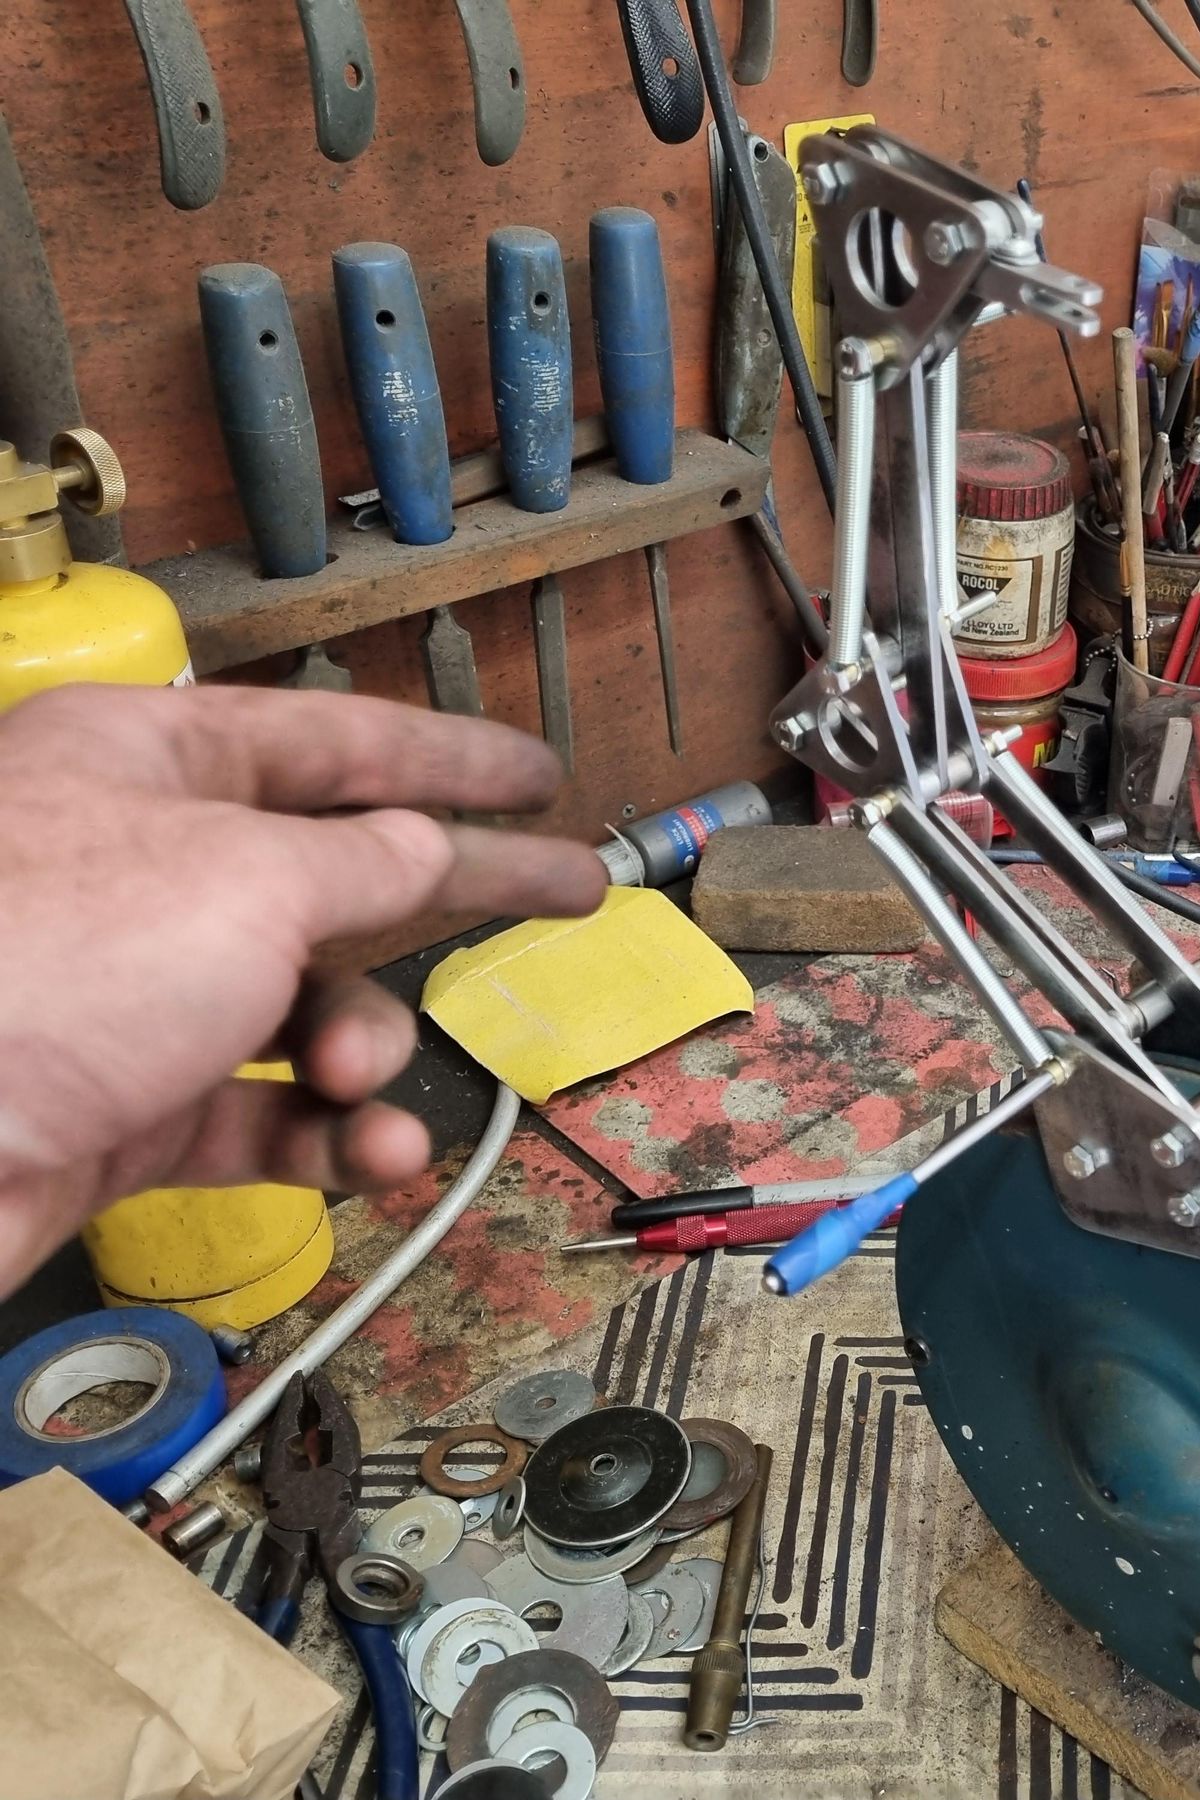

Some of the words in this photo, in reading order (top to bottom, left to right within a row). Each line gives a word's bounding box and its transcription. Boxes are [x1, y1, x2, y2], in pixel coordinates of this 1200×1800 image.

[962, 574, 1000, 591] ROCOL
[997, 622, 1014, 630] LTD
[972, 627, 988, 635] New
